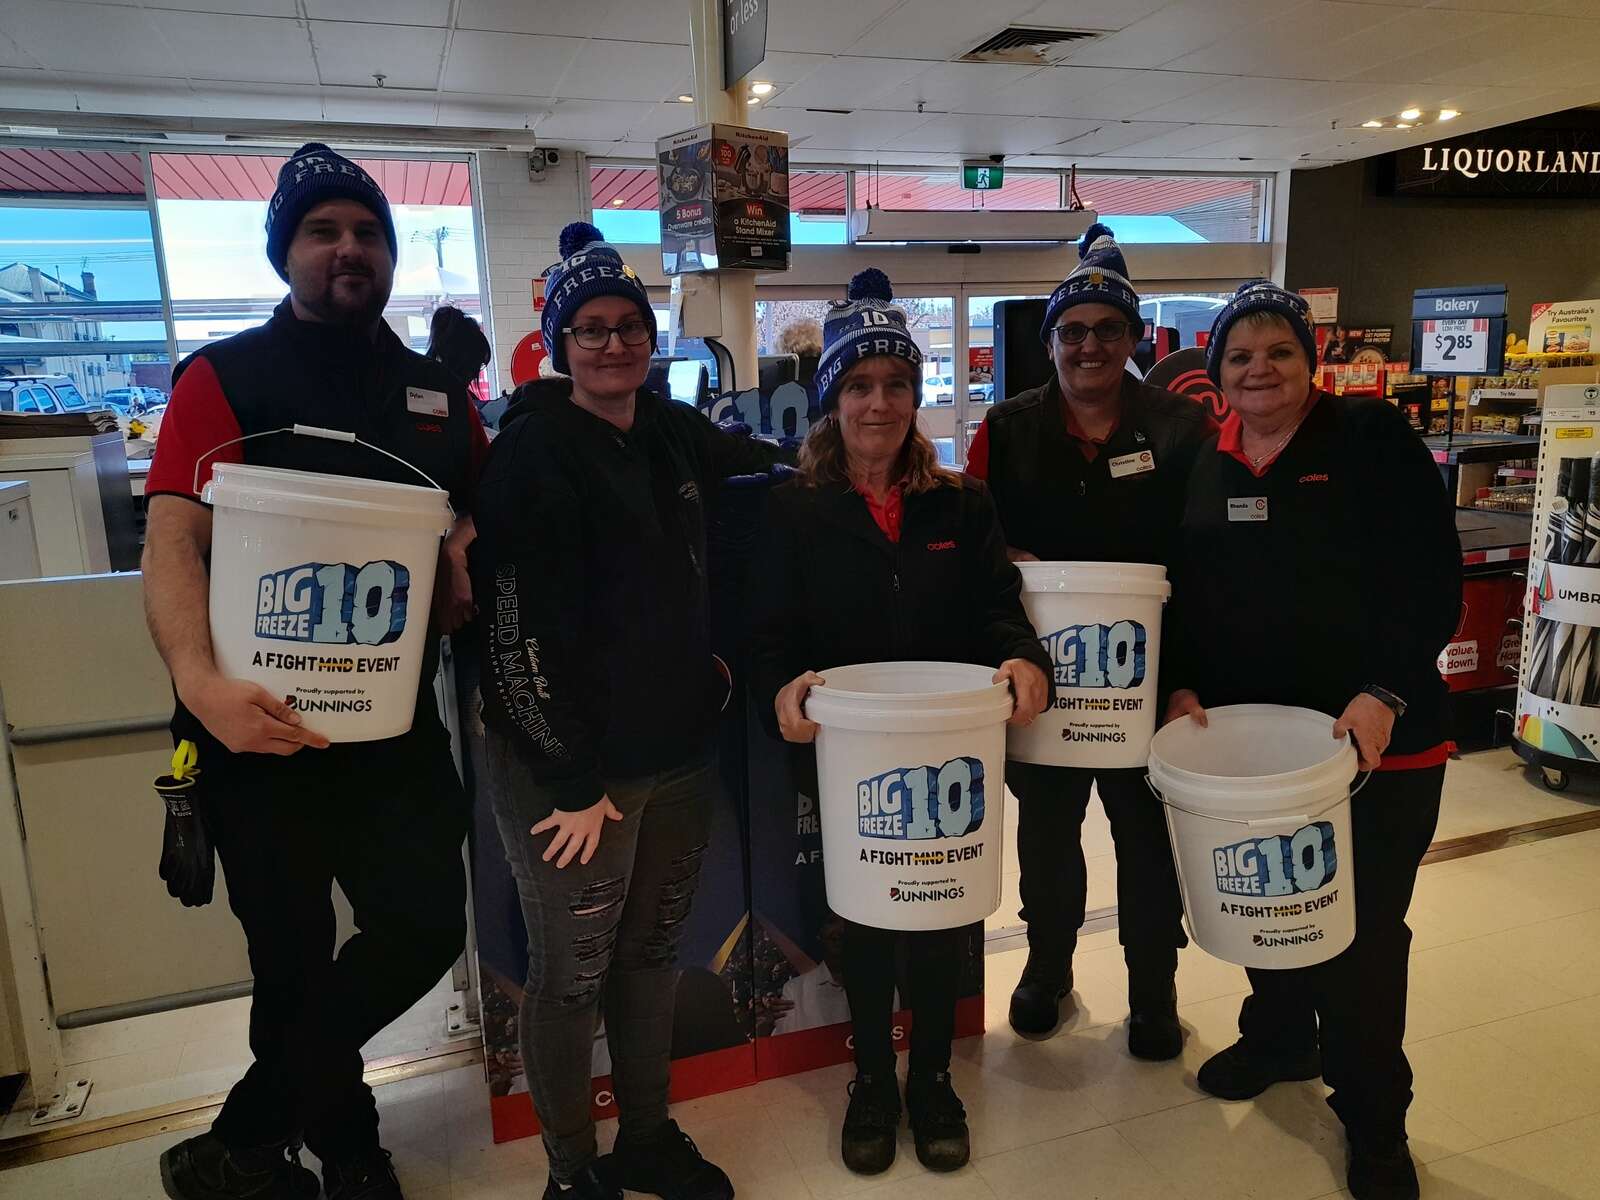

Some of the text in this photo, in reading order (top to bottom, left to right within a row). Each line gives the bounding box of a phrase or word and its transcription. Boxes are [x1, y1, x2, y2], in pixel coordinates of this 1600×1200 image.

[730, 0, 759, 36] or less
[735, 132, 769, 142] KitchenAid
[676, 207, 702, 220] 5 Bonus
[746, 204, 763, 216] Win
[694, 216, 712, 226] credits
[733, 217, 777, 228] a KitchenAid
[735, 226, 774, 237] Stand Mixer
[1434, 298, 1480, 314] Bakery
[1558, 306, 1595, 316] Australia's
[861, 310, 889, 327] 10
[855, 339, 923, 369] FREE
[820, 356, 843, 394] BIG
[735, 381, 811, 440] 10
[1299, 473, 1329, 484] coles
[927, 540, 956, 551] coles
[258, 568, 315, 616] BIG
[312, 560, 409, 646] 10
[256, 613, 310, 638] FREEZE
[496, 562, 568, 758] SPEED MACHINE
[525, 637, 541, 674] Custom
[1079, 620, 1147, 690] 10
[1446, 646, 1474, 657] value.
[252, 651, 263, 667] A
[356, 656, 401, 673] EVENT
[1447, 659, 1476, 670] down.
[296, 687, 366, 697] Proudly supported by
[284, 695, 373, 713] BUNNINGS
[1053, 697, 1144, 711] IGHTMND EVENT
[1069, 722, 1090, 730] Proudly
[1061, 728, 1127, 743] BUNNINGS
[858, 773, 902, 817] BIG
[903, 756, 986, 840] 10
[859, 814, 904, 836] FREEZE
[794, 851, 808, 866] A
[859, 848, 868, 863] A
[946, 843, 984, 864] EVENT
[1215, 842, 1259, 877] BIG
[1257, 821, 1338, 898] 10
[897, 880, 920, 888] Proudly
[921, 878, 949, 887] supported
[1217, 876, 1262, 895] FREEZE
[889, 886, 965, 902] BUNNINGS
[1220, 902, 1230, 914] A
[1304, 889, 1340, 914] EVENT
[1252, 930, 1325, 947] BUNNINGS
[1282, 926, 1308, 934] supported
